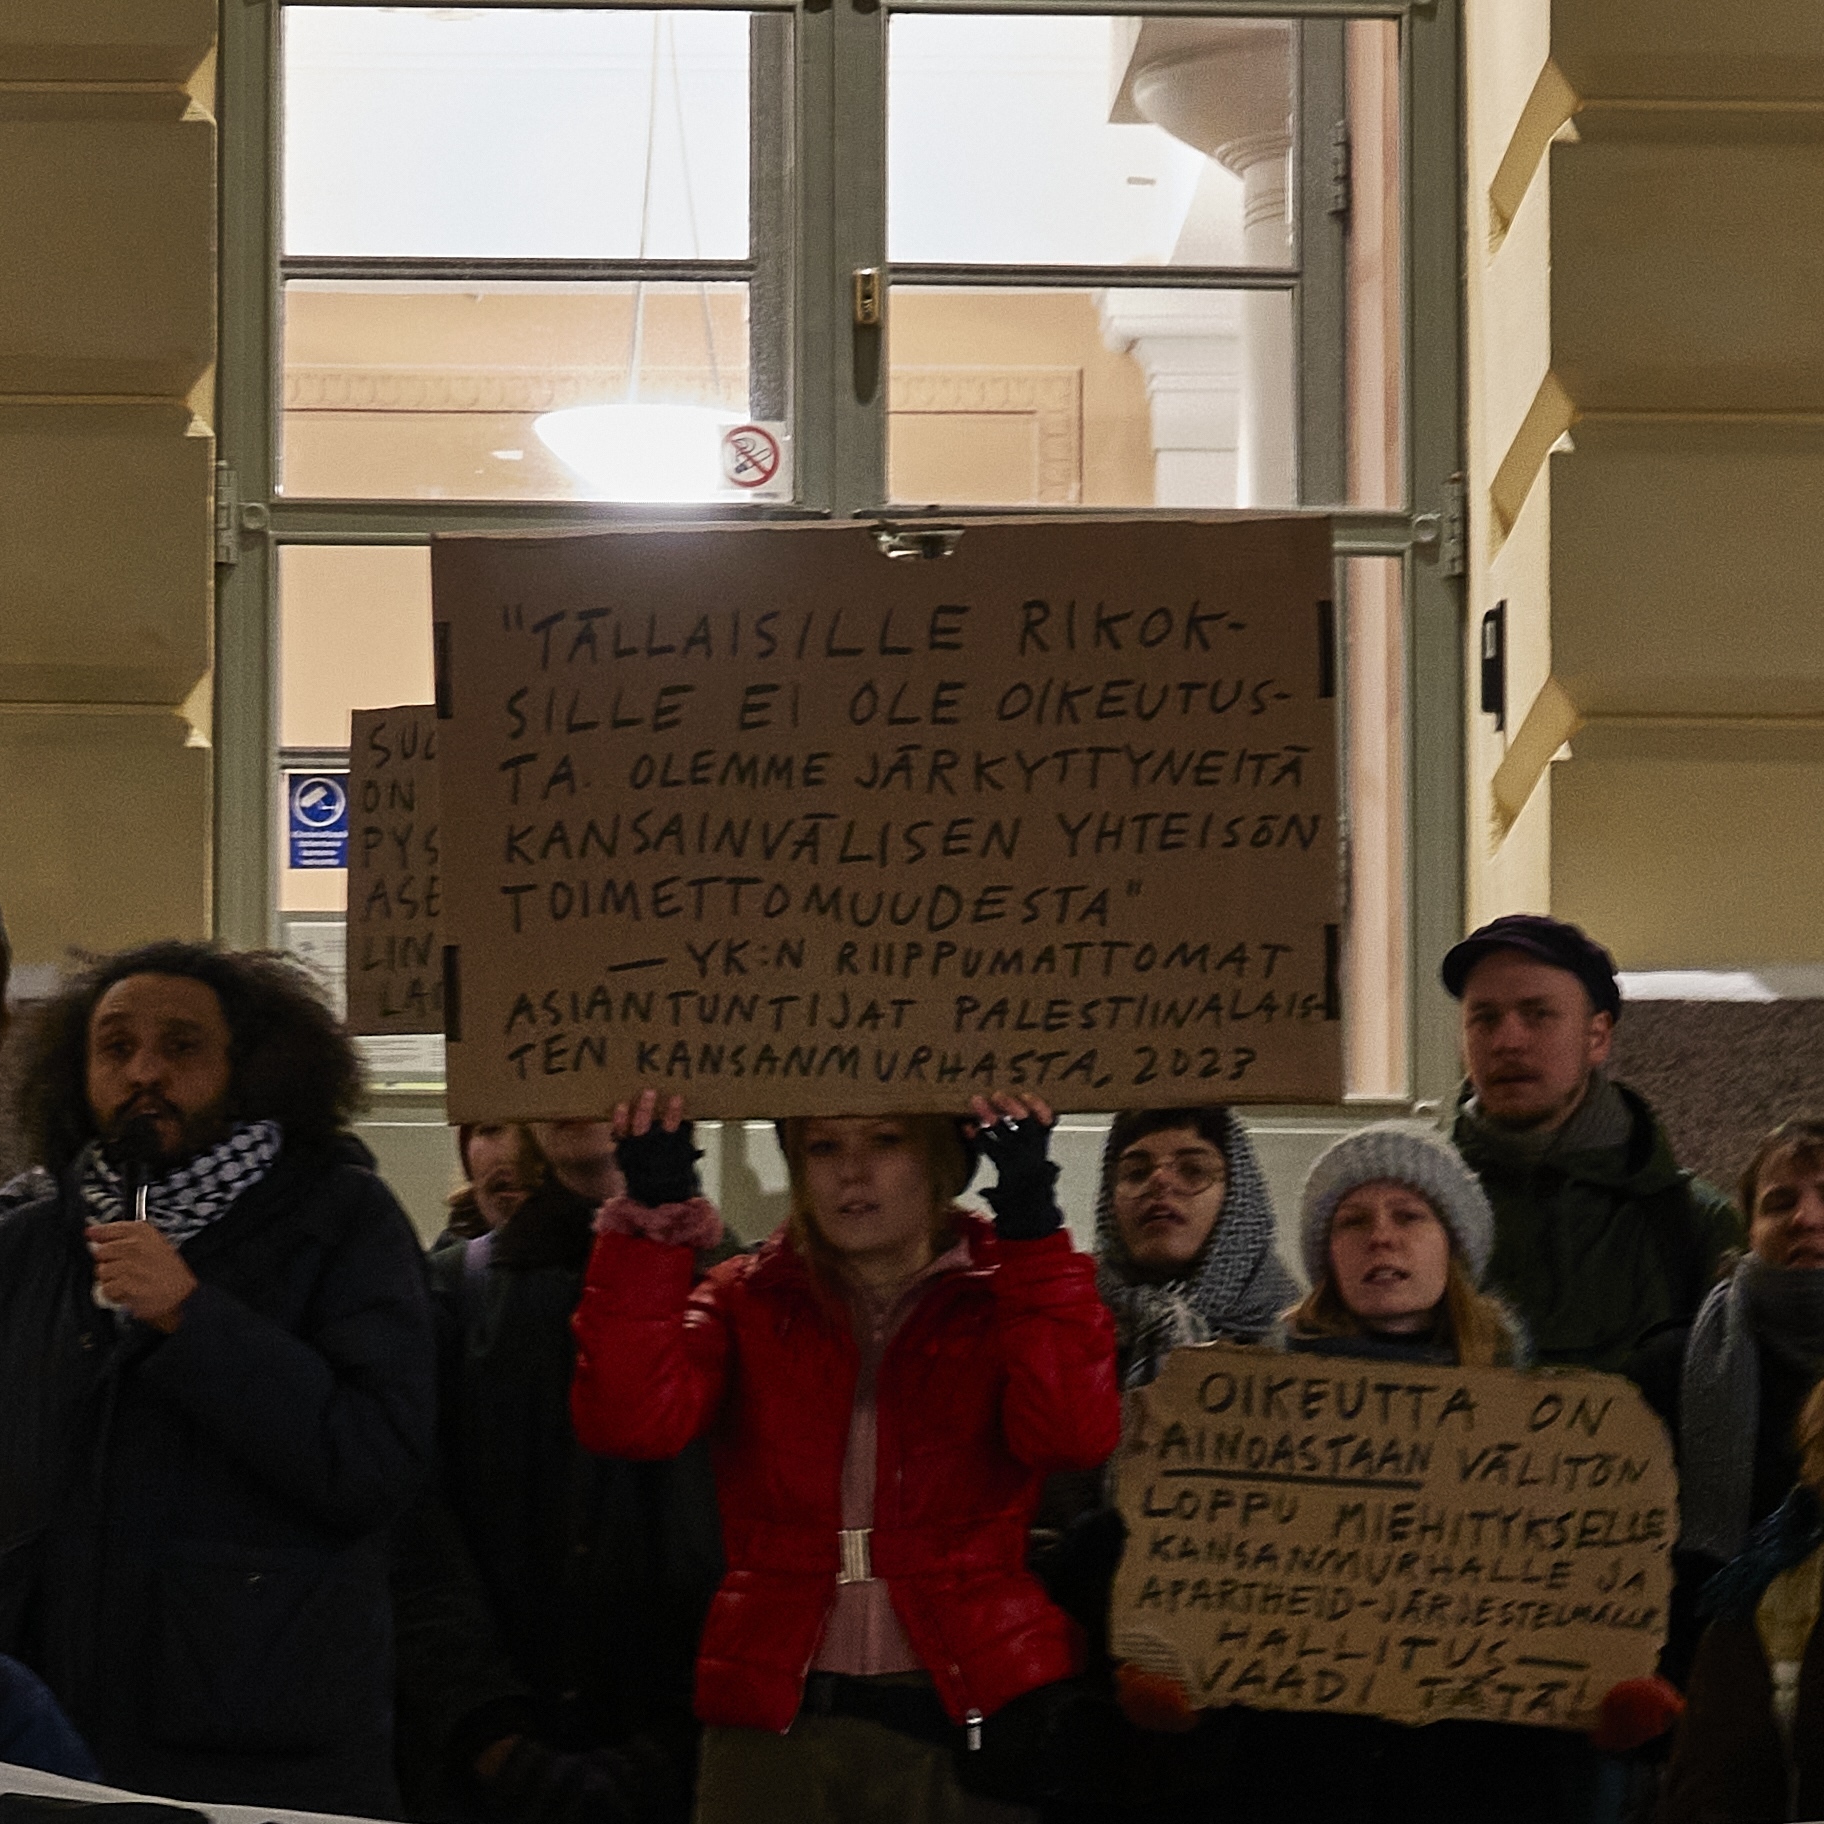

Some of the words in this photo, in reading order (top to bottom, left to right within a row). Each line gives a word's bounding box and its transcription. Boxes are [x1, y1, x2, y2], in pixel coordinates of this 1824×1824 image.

[1019, 599, 1247, 657] RIKOK-
[505, 683, 697, 741] SILLE
[738, 681, 802, 733] EI
[848, 677, 968, 727] OLE
[997, 677, 1293, 727] OIKEUTUS-
[629, 748, 832, 791] OLEMME
[836, 938, 1294, 980] RIIPPUMATTOMAT
[503, 984, 919, 1036] ASIANTUNTIJAT
[507, 1031, 608, 1082] TEN
[1131, 1045, 1258, 1087] 2023
[1196, 1371, 1477, 1433] OIKEUTTA
[1528, 1393, 1613, 1438] ON
[1156, 1420, 1433, 1478] AINOASTAAN
[1141, 1483, 1298, 1529] LOPPU
[1596, 1555, 1646, 1593] JA
[1194, 1658, 1375, 1705] VAADI
